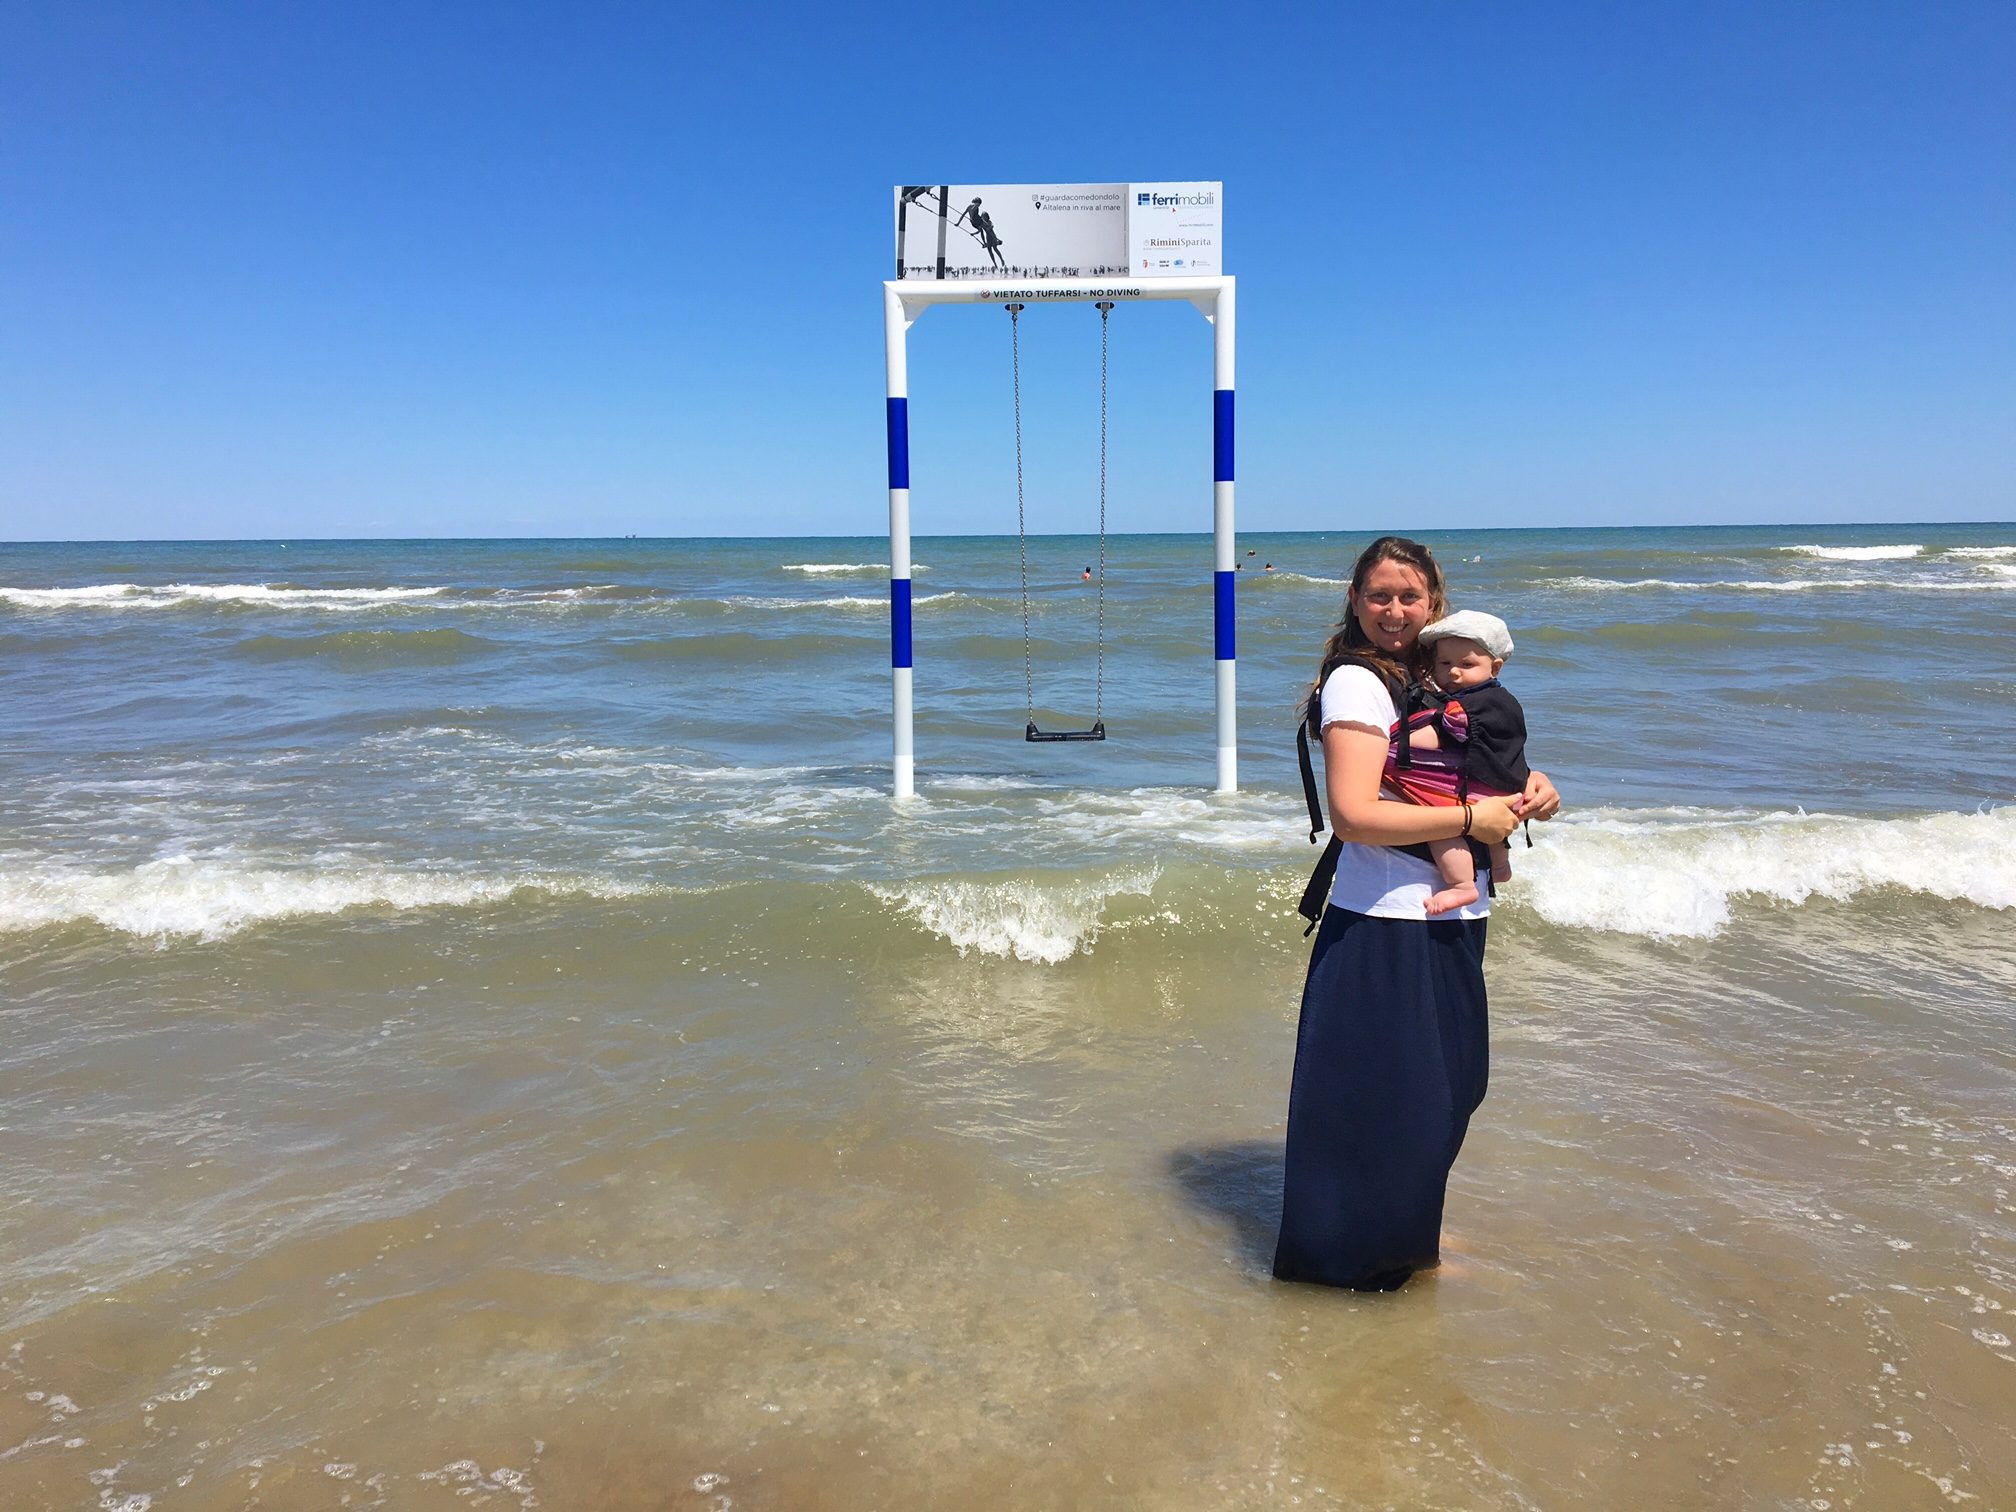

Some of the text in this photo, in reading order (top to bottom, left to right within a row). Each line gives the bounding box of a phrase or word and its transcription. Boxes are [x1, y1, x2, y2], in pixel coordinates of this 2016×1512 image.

[1040, 193, 1120, 202] #guardacomedondolo
[1152, 192, 1214, 206] ferrimobili
[1150, 238, 1211, 247] RiminiSparita
[993, 290, 1033, 298] VIETATO
[1036, 290, 1081, 298] TUFFARSI
[1090, 289, 1104, 297] NO
